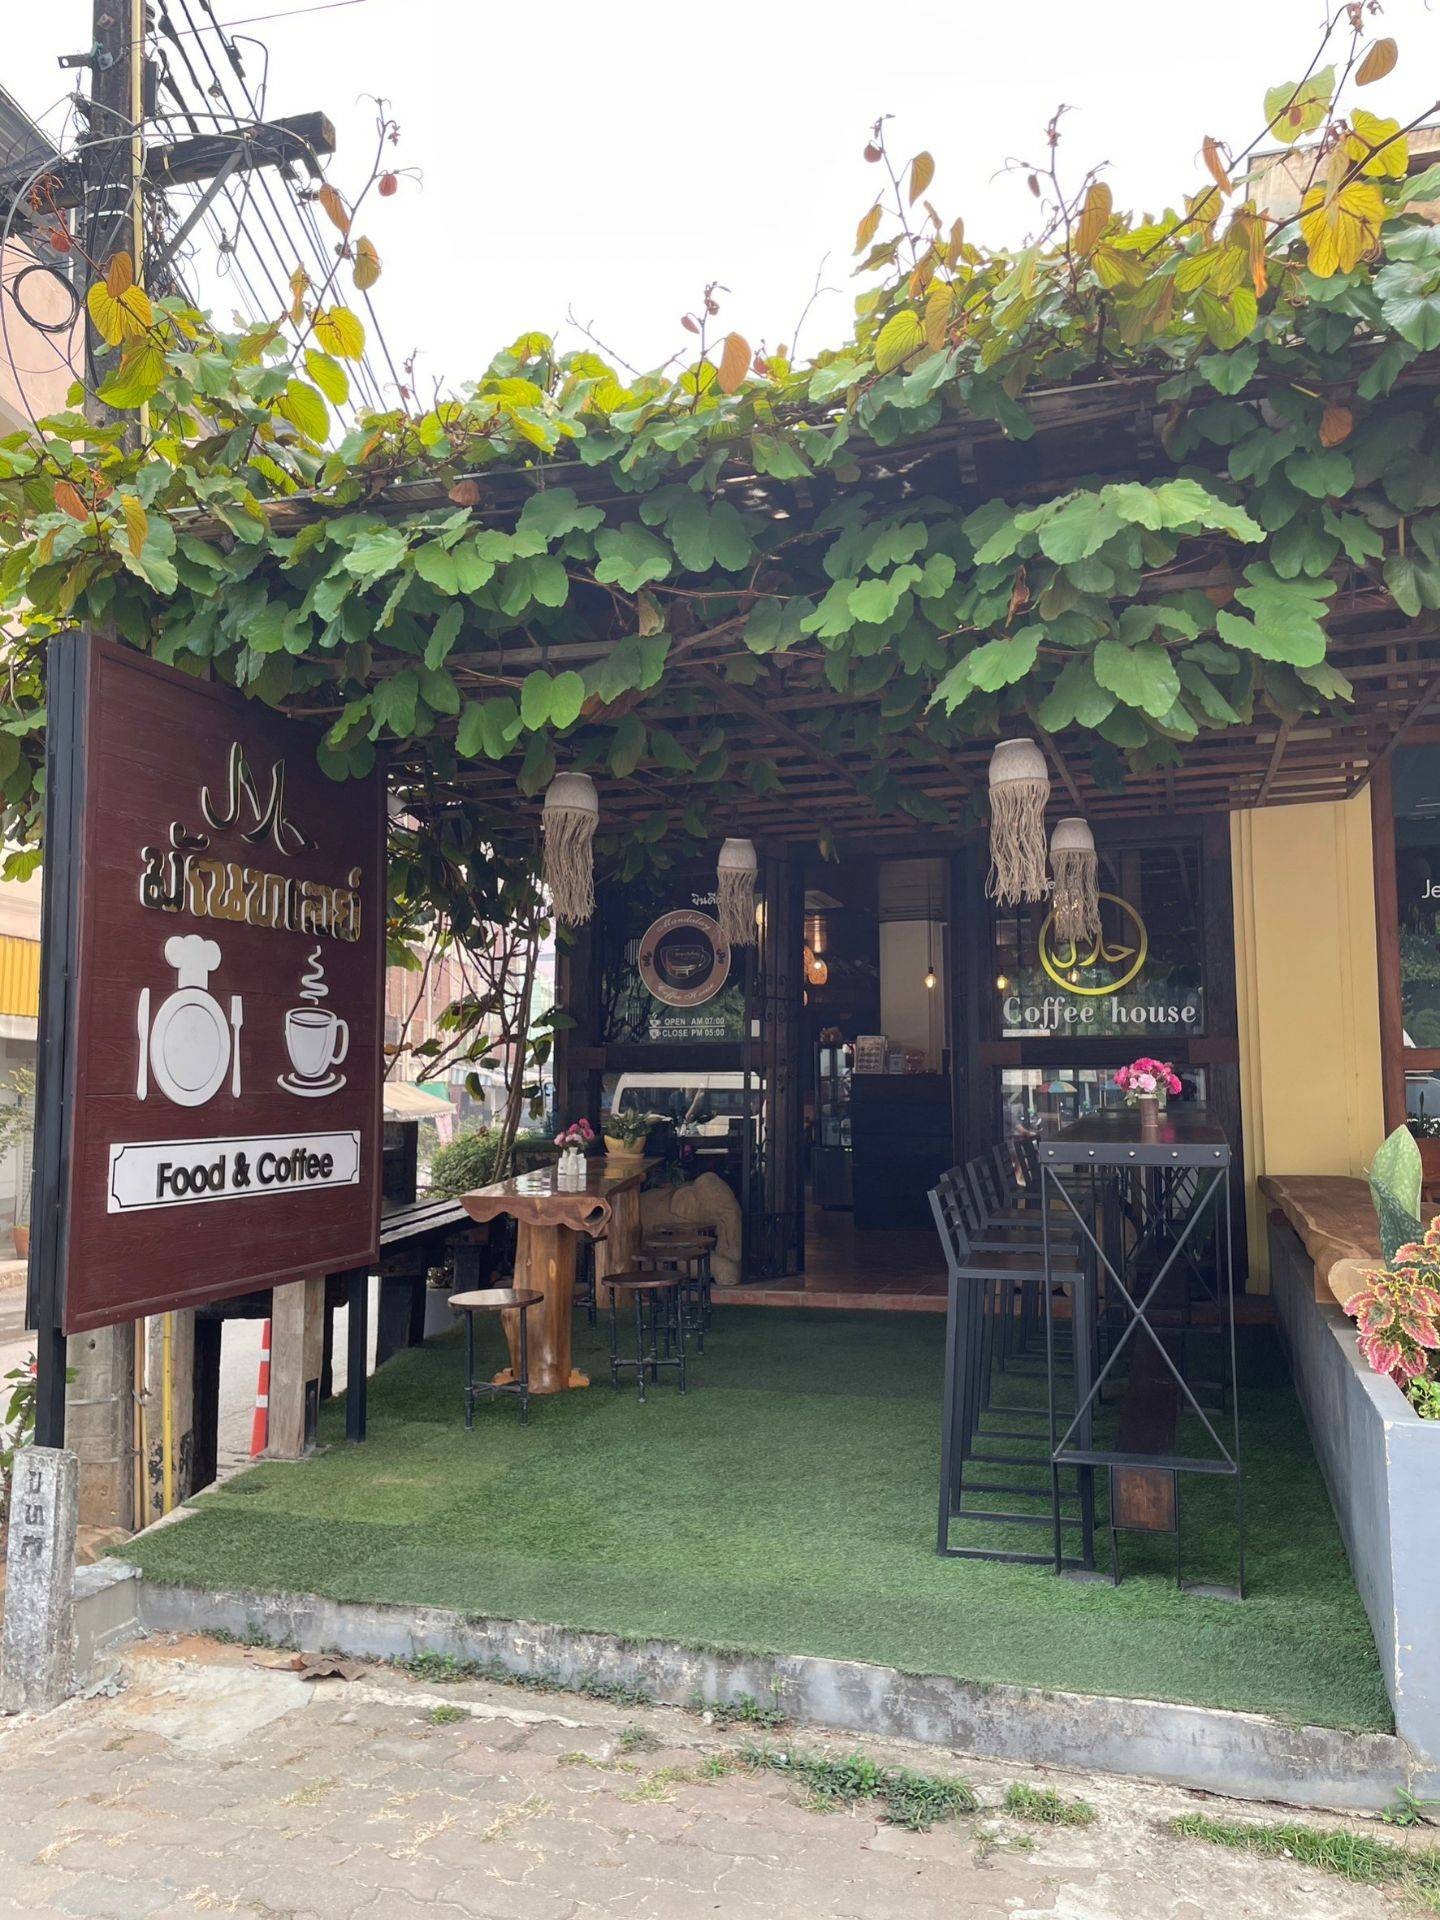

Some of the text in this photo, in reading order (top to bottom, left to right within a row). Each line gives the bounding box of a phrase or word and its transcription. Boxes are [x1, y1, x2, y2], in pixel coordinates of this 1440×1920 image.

[691, 1017, 704, 1025] AM
[1003, 997, 1197, 1029] Coffee house
[662, 1029, 689, 1037] CLOSE
[691, 1029, 704, 1037] PM
[156, 1148, 334, 1198] Food & Coffee
